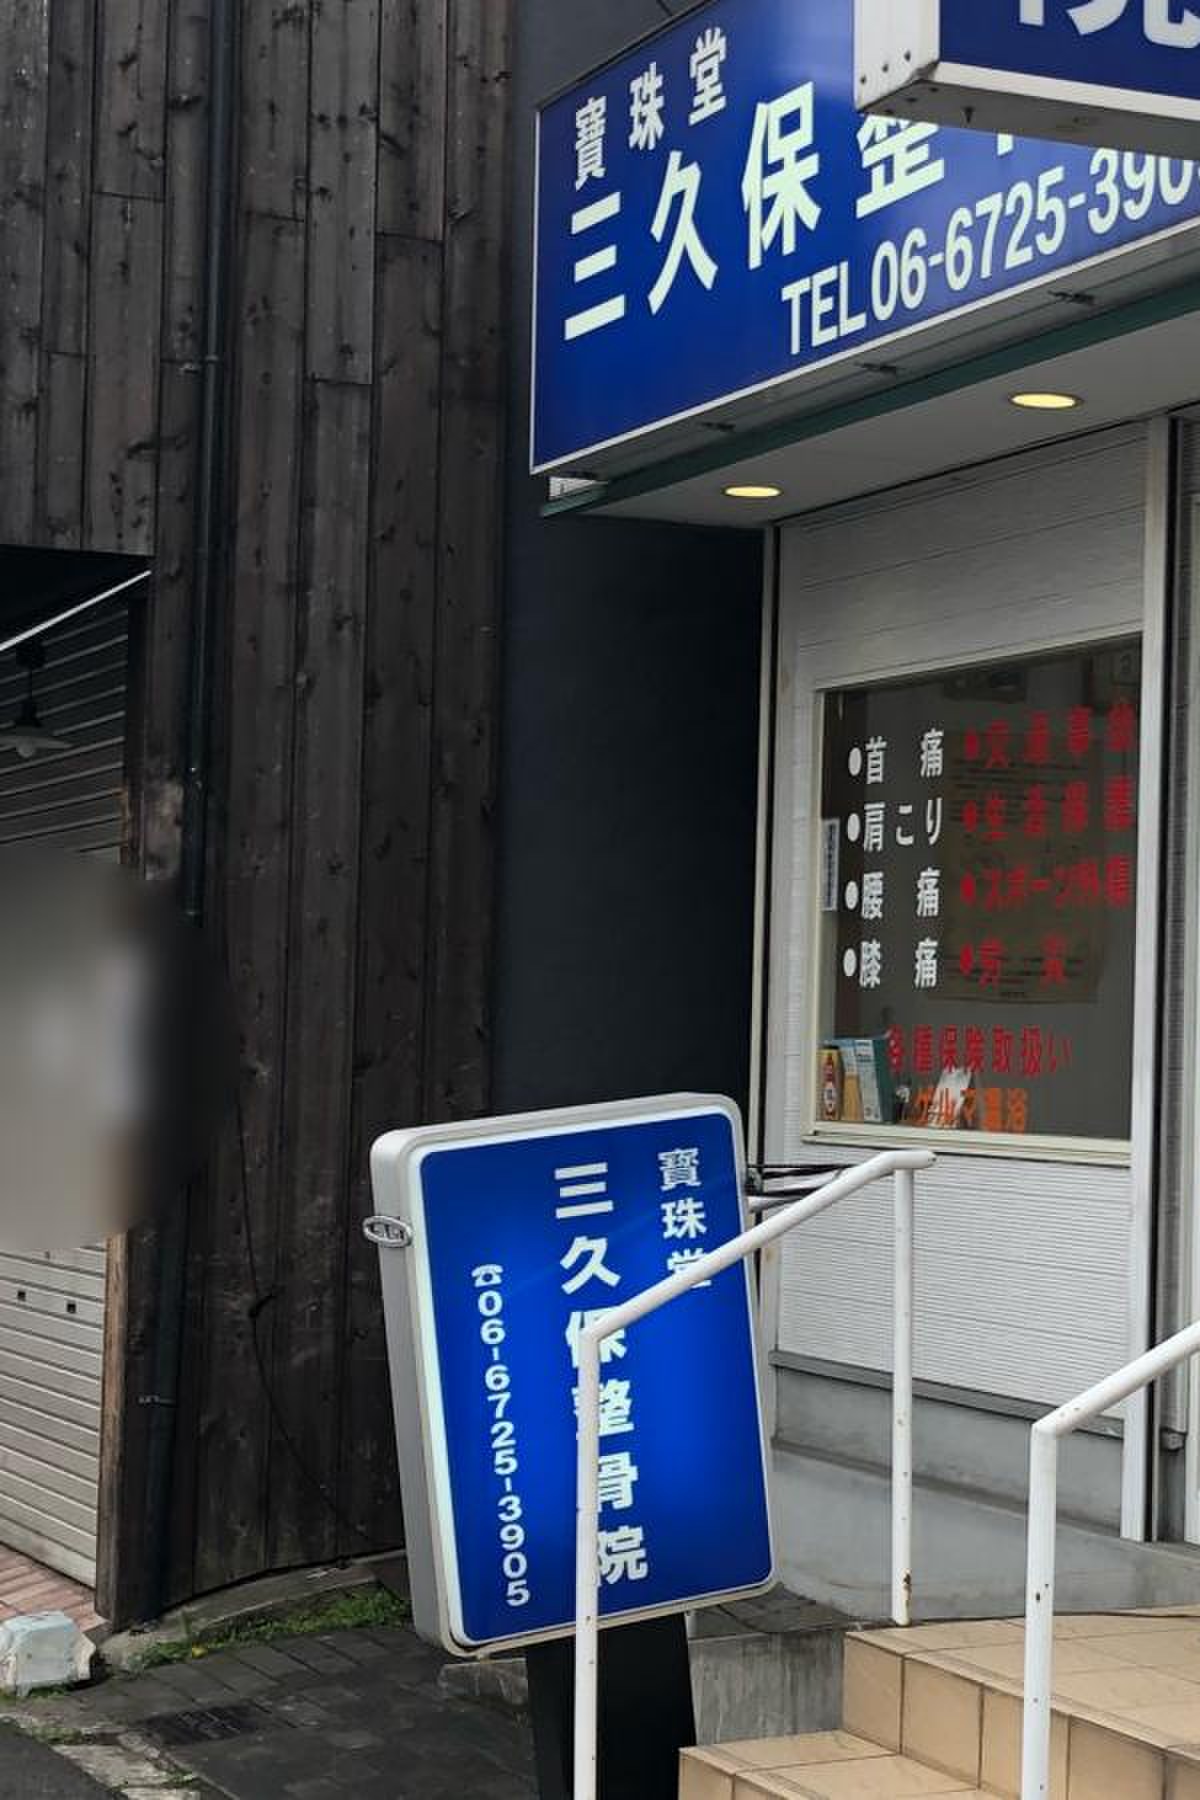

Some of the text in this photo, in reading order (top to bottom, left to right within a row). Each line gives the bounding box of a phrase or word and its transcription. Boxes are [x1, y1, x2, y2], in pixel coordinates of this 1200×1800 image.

[574, 27, 727, 192] 寶珠堂
[565, 81, 1013, 341] 三久保整
[782, 262, 866, 356] TEL
[864, 797, 943, 851] 肩こり
[478, 1290, 530, 1607] 06-6725-3905
